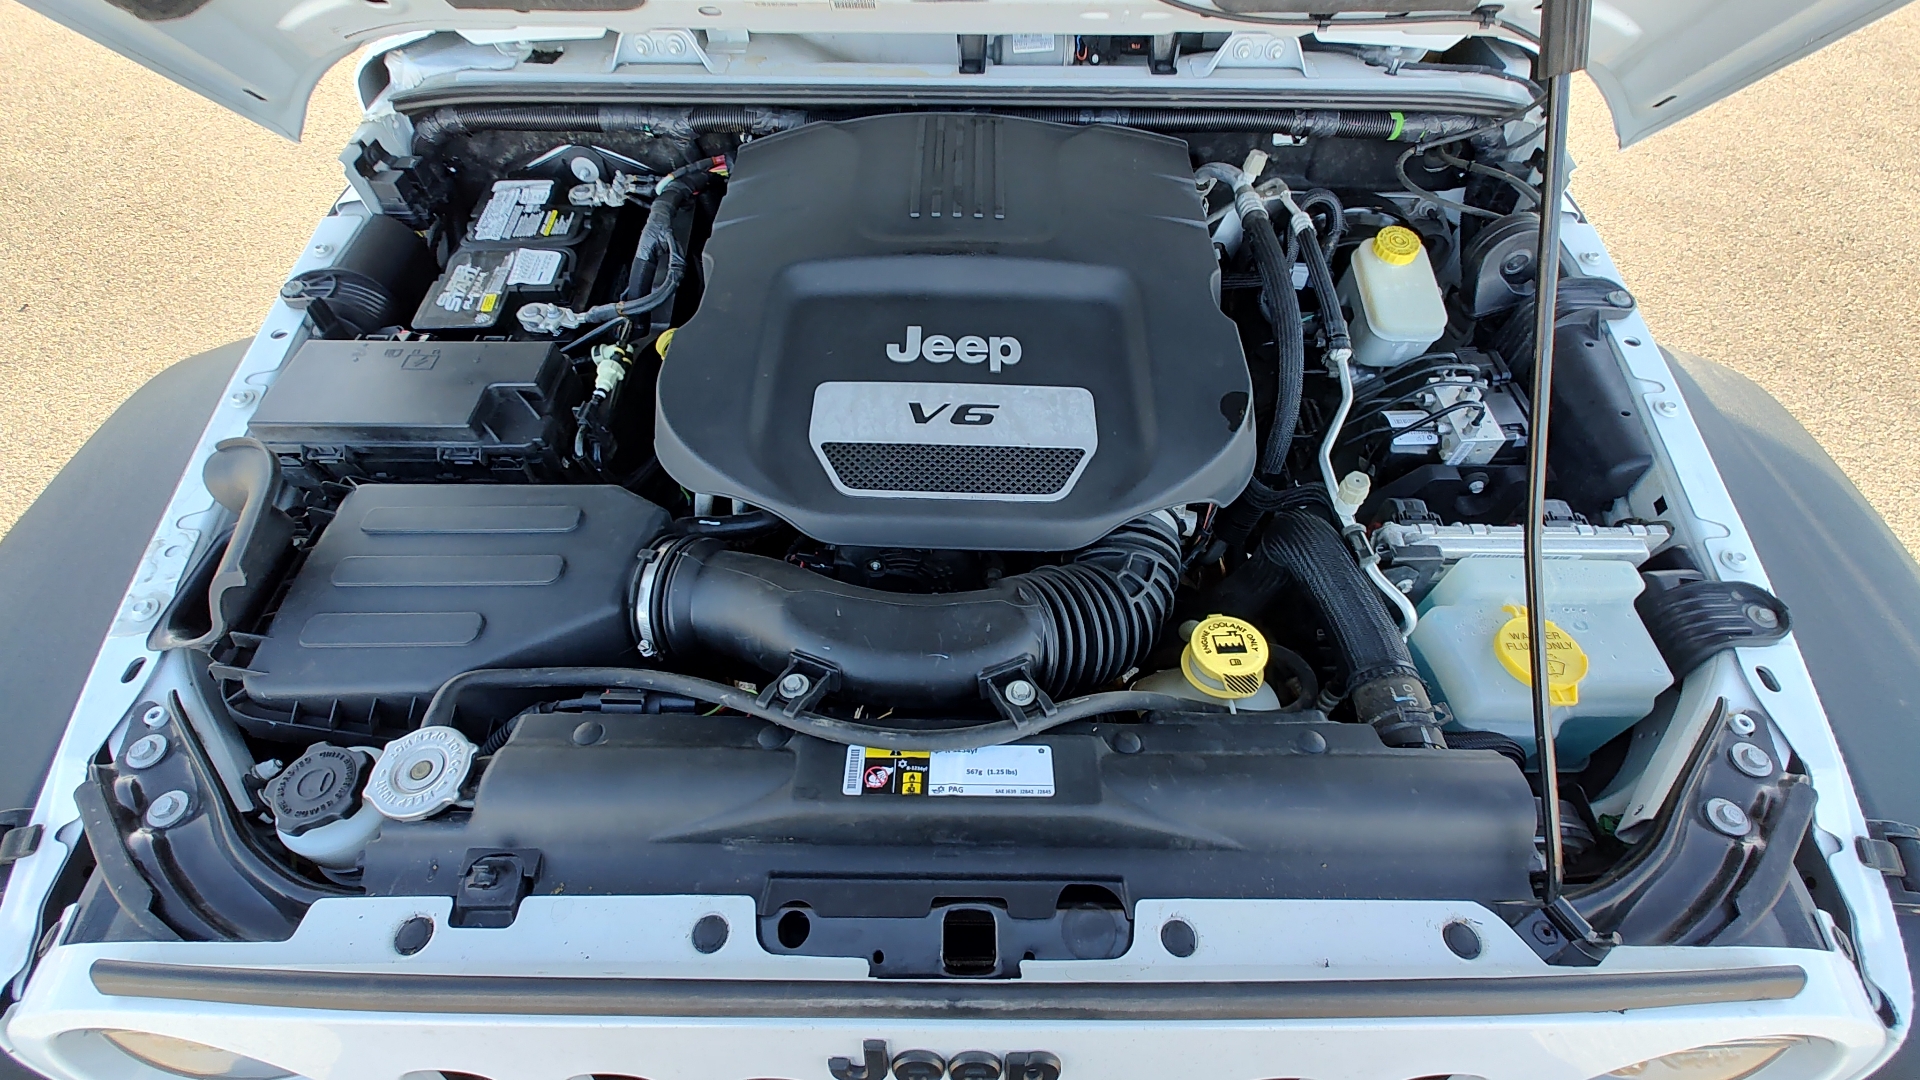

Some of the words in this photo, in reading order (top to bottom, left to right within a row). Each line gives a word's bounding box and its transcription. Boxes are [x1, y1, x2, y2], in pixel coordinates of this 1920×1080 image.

[886, 325, 1022, 373] Jeep
[908, 402, 1000, 425] V6
[1201, 630, 1212, 654] ENGINE
[1208, 622, 1247, 633] COOLANT
[1246, 633, 1259, 652] ONLY
[1509, 632, 1561, 640] WAER
[1505, 642, 1529, 650] FLU
[414, 731, 448, 744] OPEN
[965, 768, 983, 776] 567g
[987, 768, 1005, 776] (1.25
[1005, 768, 1018, 776] lbs)
[948, 785, 964, 793] PAG
